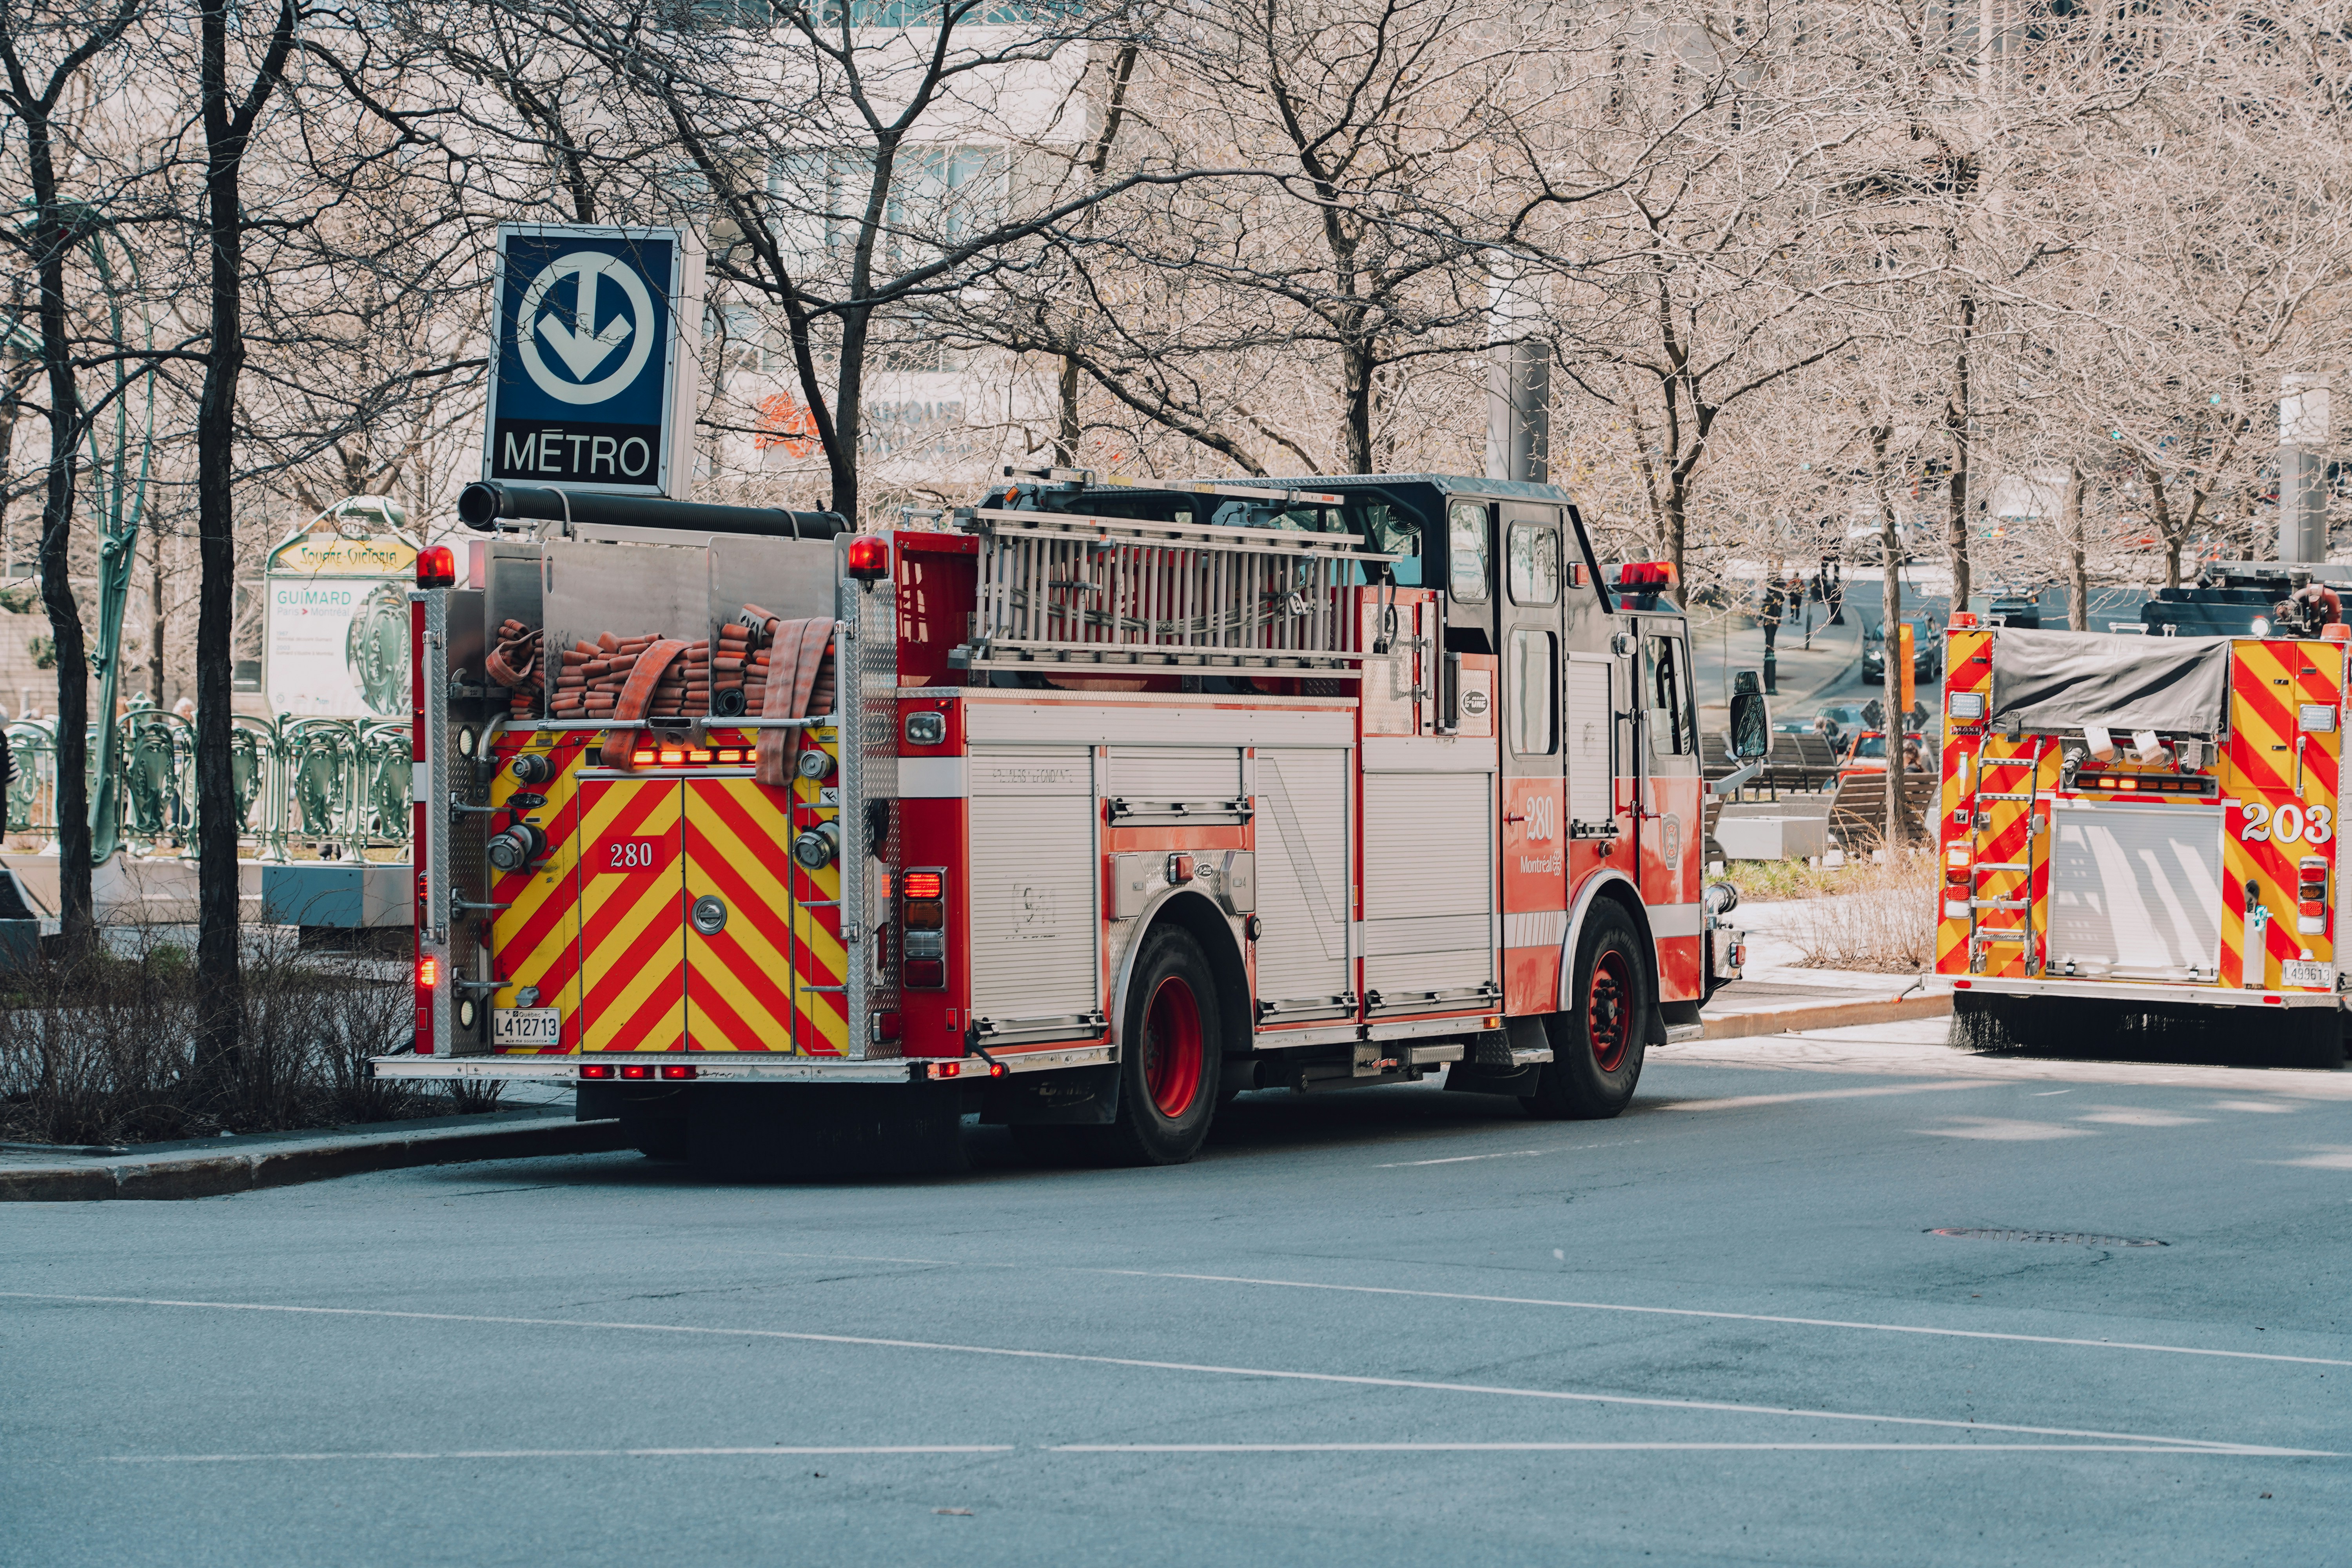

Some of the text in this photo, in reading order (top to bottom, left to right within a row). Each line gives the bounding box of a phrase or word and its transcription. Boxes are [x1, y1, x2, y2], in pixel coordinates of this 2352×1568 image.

[504, 429, 650, 476] MÉTRO
[278, 591, 351, 604] GUIMARD
[277, 607, 350, 616] Paris Montréal
[1526, 795, 1554, 841] 280
[2241, 802, 2332, 844] 203
[610, 842, 652, 867] 280
[1520, 855, 1552, 873] Montréal
[2285, 967, 2329, 980] L499613
[495, 1018, 556, 1036] L412713
